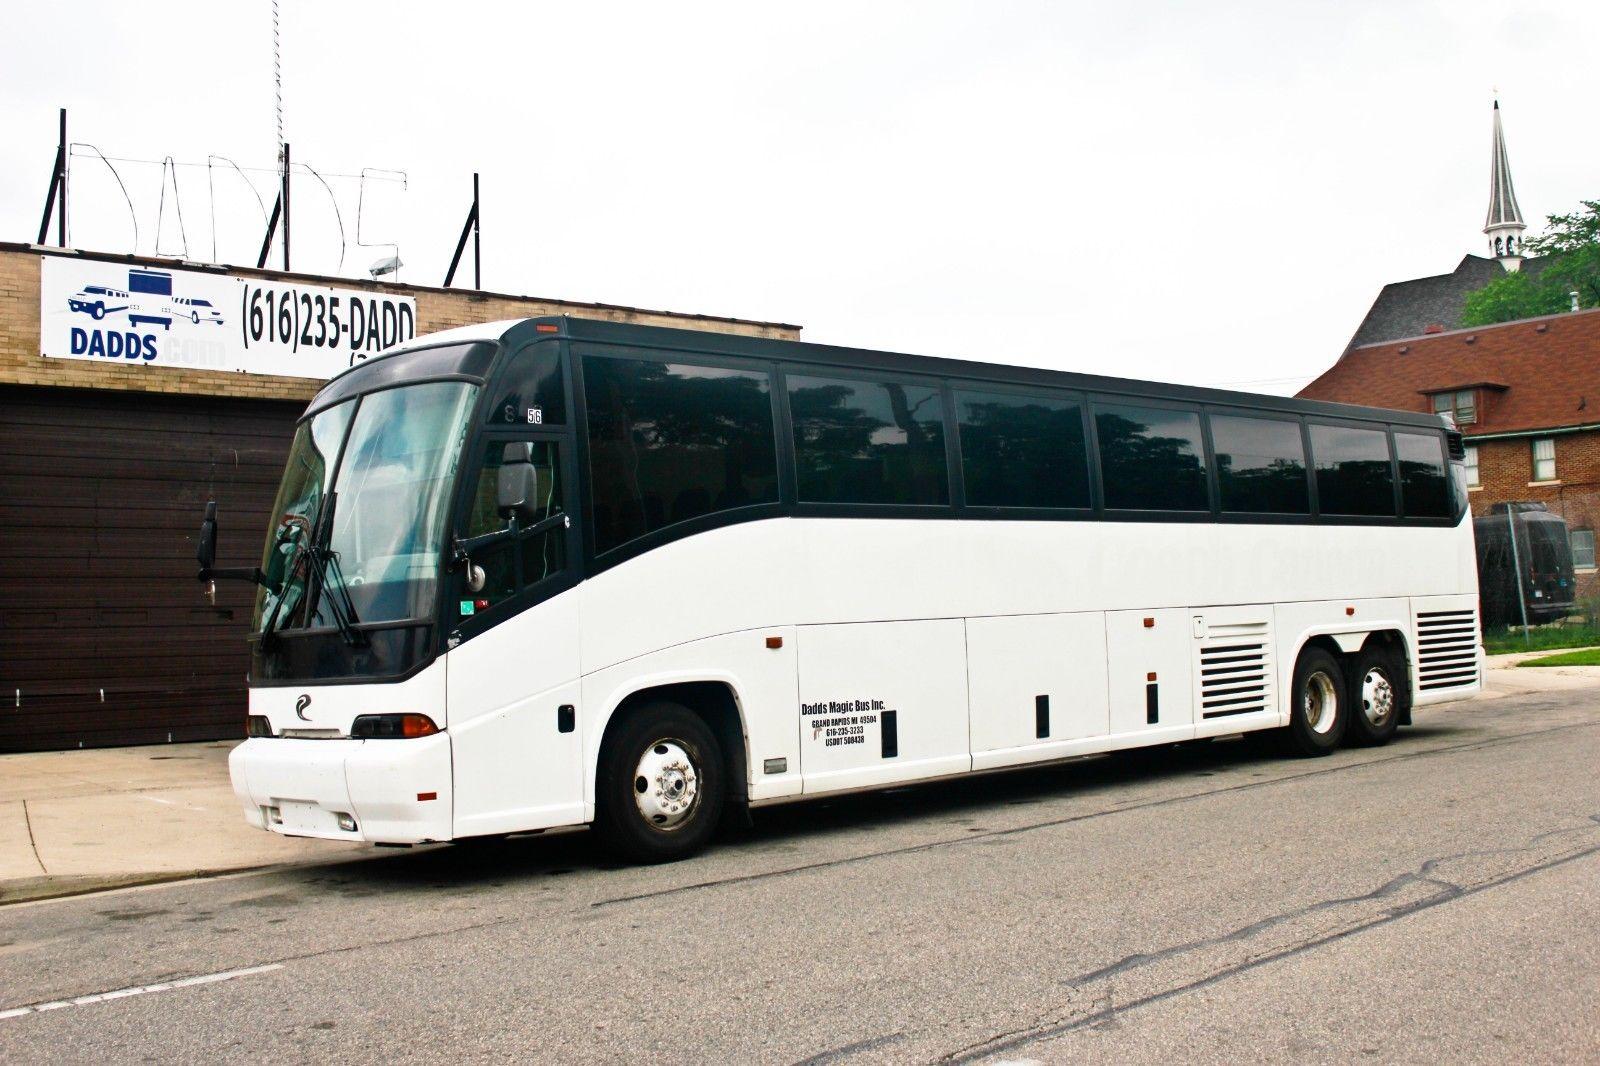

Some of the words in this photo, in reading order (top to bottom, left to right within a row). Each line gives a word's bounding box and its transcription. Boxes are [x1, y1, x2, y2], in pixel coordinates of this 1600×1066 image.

[243, 284, 413, 352] (616)235-DADD
[529, 409, 541, 423] 56
[802, 703, 827, 715] Dadds
[829, 701, 853, 713] Magic
[855, 700, 870, 711] Bus
[872, 699, 885, 710] Inc.
[812, 719, 830, 728] GRAND
[831, 718, 850, 726] RAPIDS
[860, 715, 876, 723] 49504
